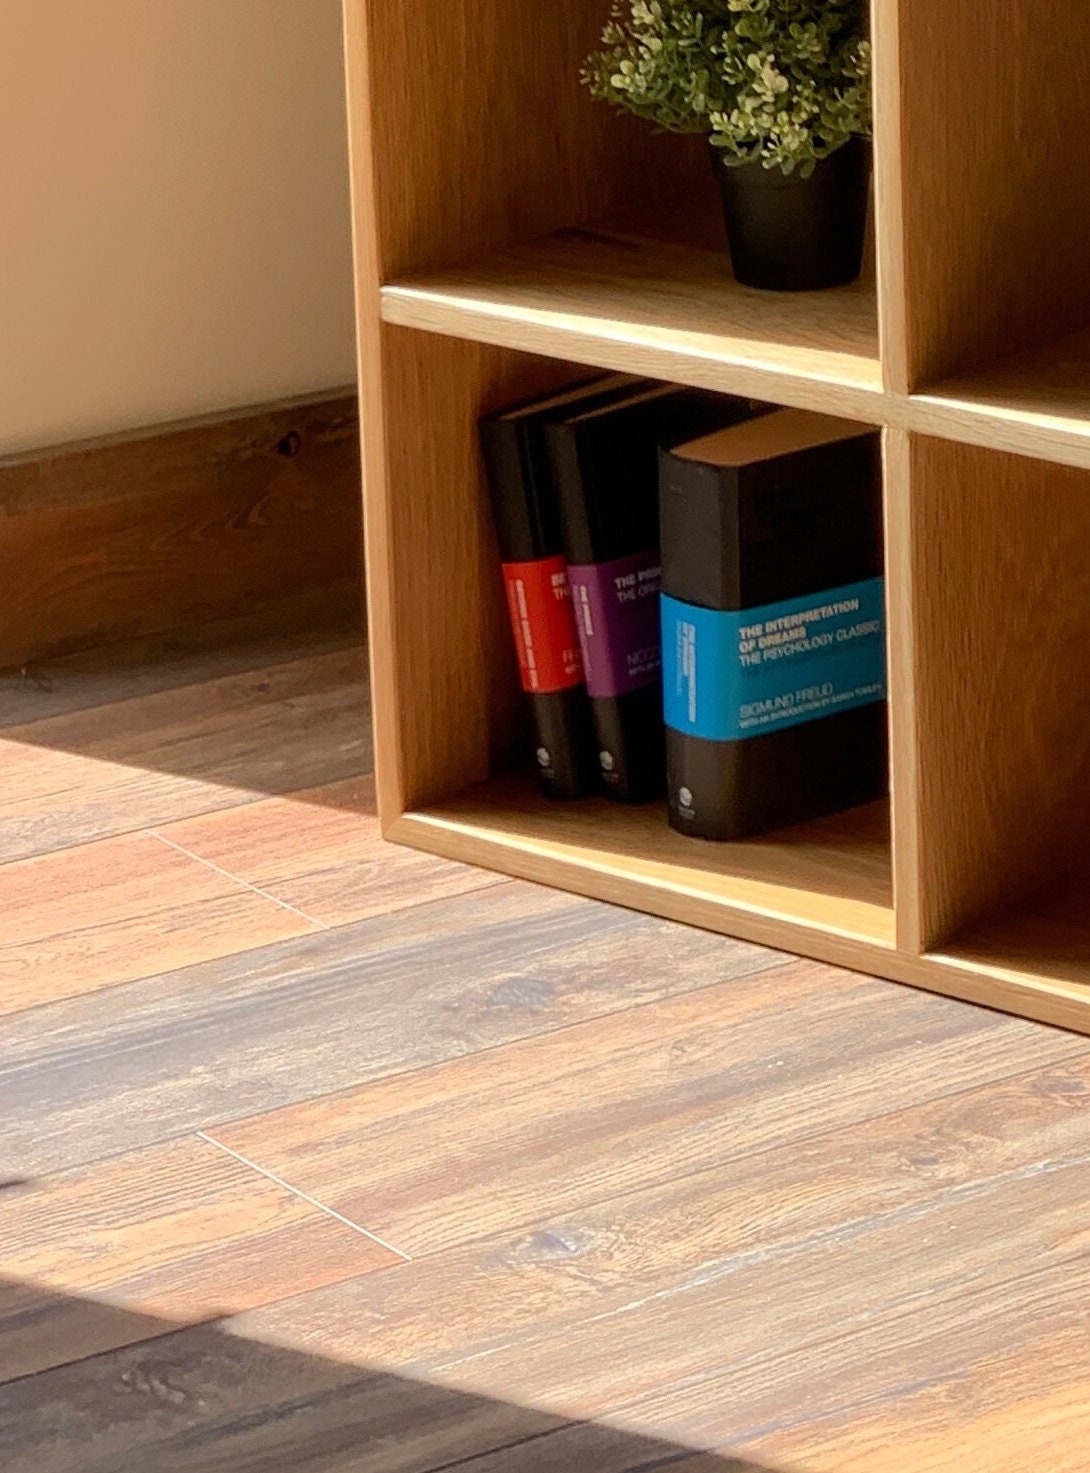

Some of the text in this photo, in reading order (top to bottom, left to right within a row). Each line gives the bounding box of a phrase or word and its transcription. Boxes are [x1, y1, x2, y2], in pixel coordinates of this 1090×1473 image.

[614, 573, 636, 589] THE
[739, 598, 859, 639] THE INTERPRETATION
[739, 626, 806, 653] OF DREAMS
[739, 651, 761, 667] THE
[763, 632, 834, 662] PSYCHOLOGY
[740, 682, 833, 718] SIGMUND FREUD
